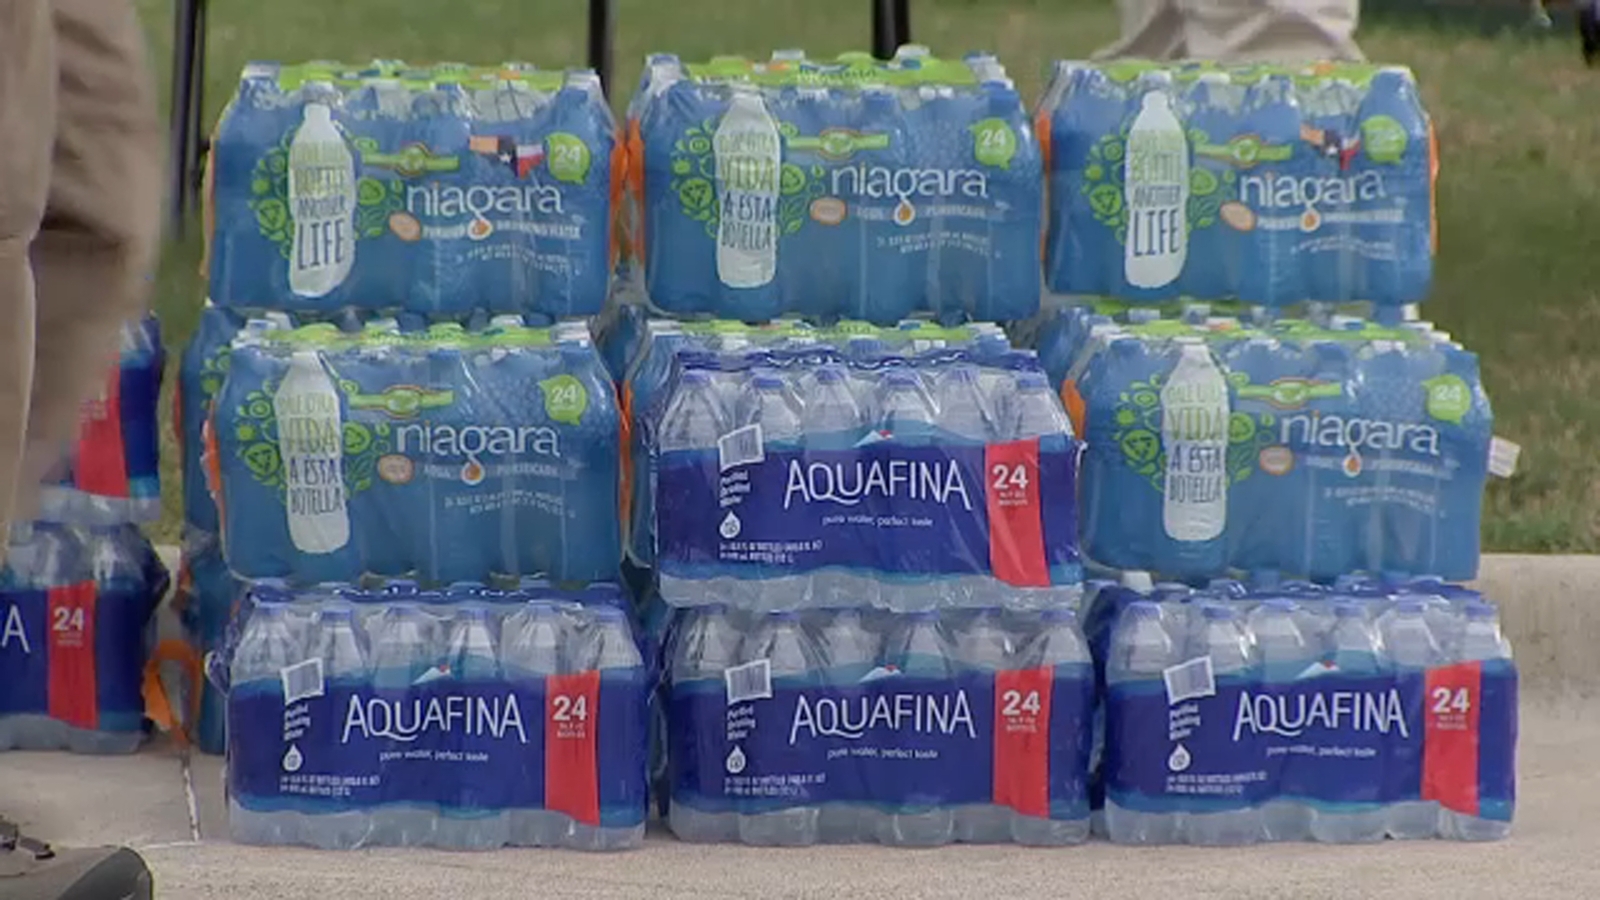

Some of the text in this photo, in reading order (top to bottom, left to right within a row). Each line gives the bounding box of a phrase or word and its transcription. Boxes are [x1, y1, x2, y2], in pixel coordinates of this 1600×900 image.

[981, 129, 1006, 147] 24
[555, 145, 581, 163] 24
[722, 191, 772, 222] A ESTA
[832, 162, 989, 225] niagara
[1240, 169, 1386, 232] niagara
[407, 181, 565, 240] niagara
[298, 219, 345, 270] LIFE
[722, 221, 771, 250] BOTELLA
[1133, 206, 1180, 257] LIFE
[552, 384, 577, 403] 24
[280, 417, 336, 453] VIDA
[1168, 407, 1222, 441] VIDA
[396, 421, 561, 485] niagara
[1171, 444, 1221, 473] A ESTA
[1281, 410, 1440, 477] niagara
[290, 456, 338, 485] A ESTA
[784, 459, 972, 510] AQUAFINA
[992, 464, 1029, 489] 24
[291, 487, 343, 515] BOTELLA
[1169, 475, 1221, 503] BOTELLA
[53, 607, 84, 631] 24
[553, 694, 587, 721] 24
[1002, 690, 1041, 716] 24
[1232, 688, 1410, 741] AQUAFINA
[1432, 686, 1470, 713] 24
[342, 694, 527, 744] AQUAFINA
[789, 690, 976, 745] AQUAFINA
